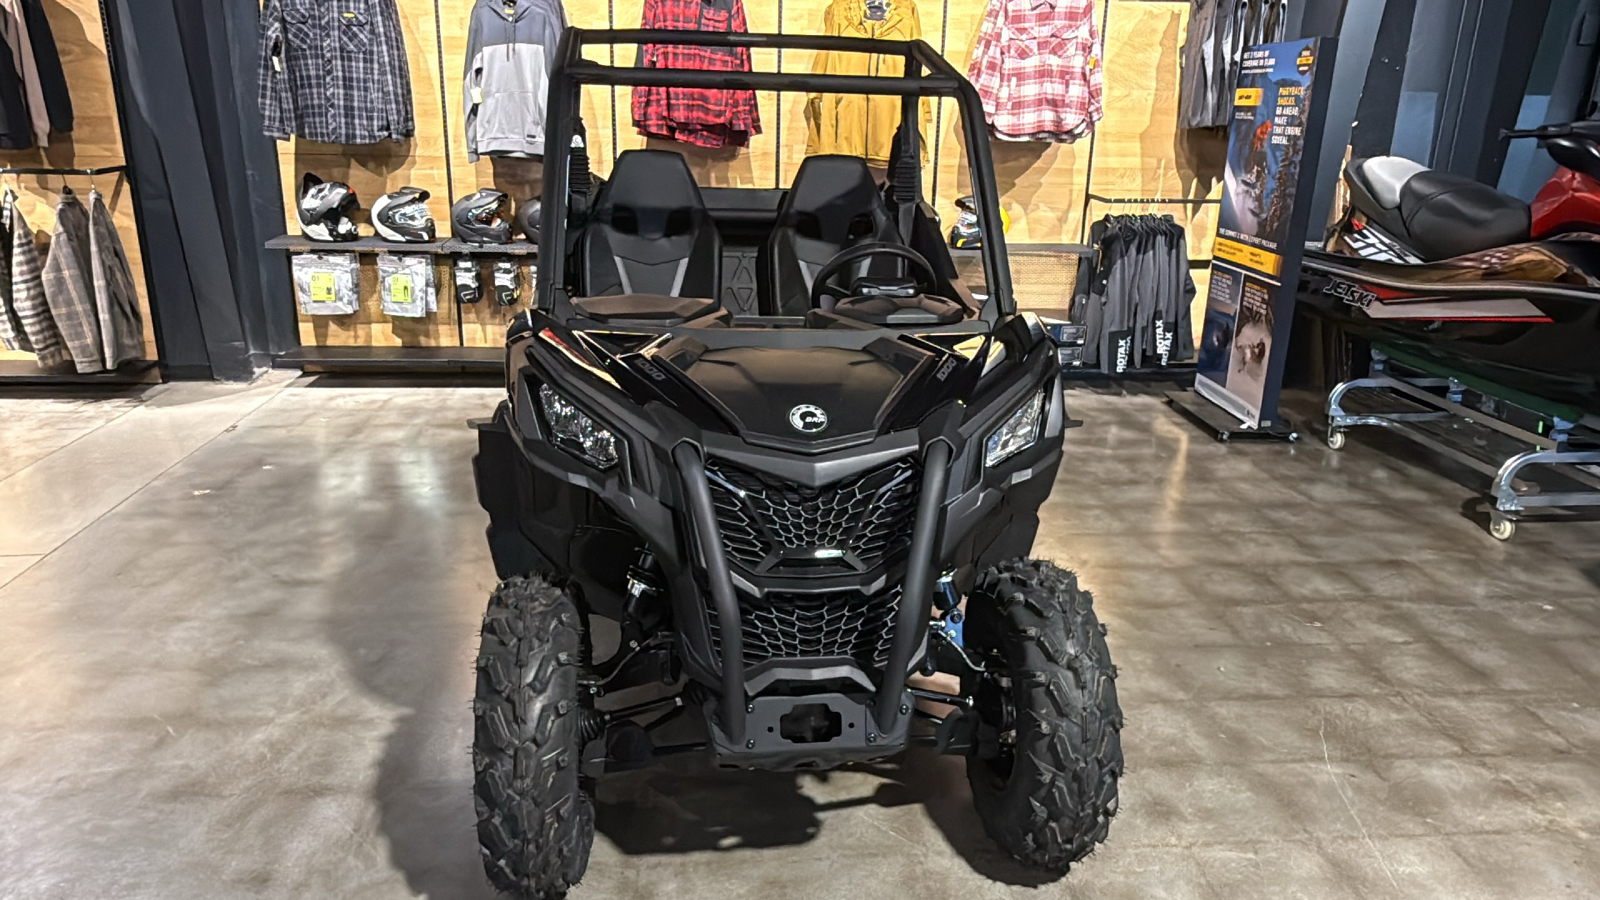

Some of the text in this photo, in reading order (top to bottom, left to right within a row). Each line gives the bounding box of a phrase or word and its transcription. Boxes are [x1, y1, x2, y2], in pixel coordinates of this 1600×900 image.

[1276, 106, 1282, 115] GO
[1274, 116, 1287, 125] MAKE
[1273, 126, 1302, 136] THAT ENGINE
[1116, 339, 1126, 373] ROTAX
[634, 358, 667, 381] 1000
[936, 357, 957, 381] 1000
